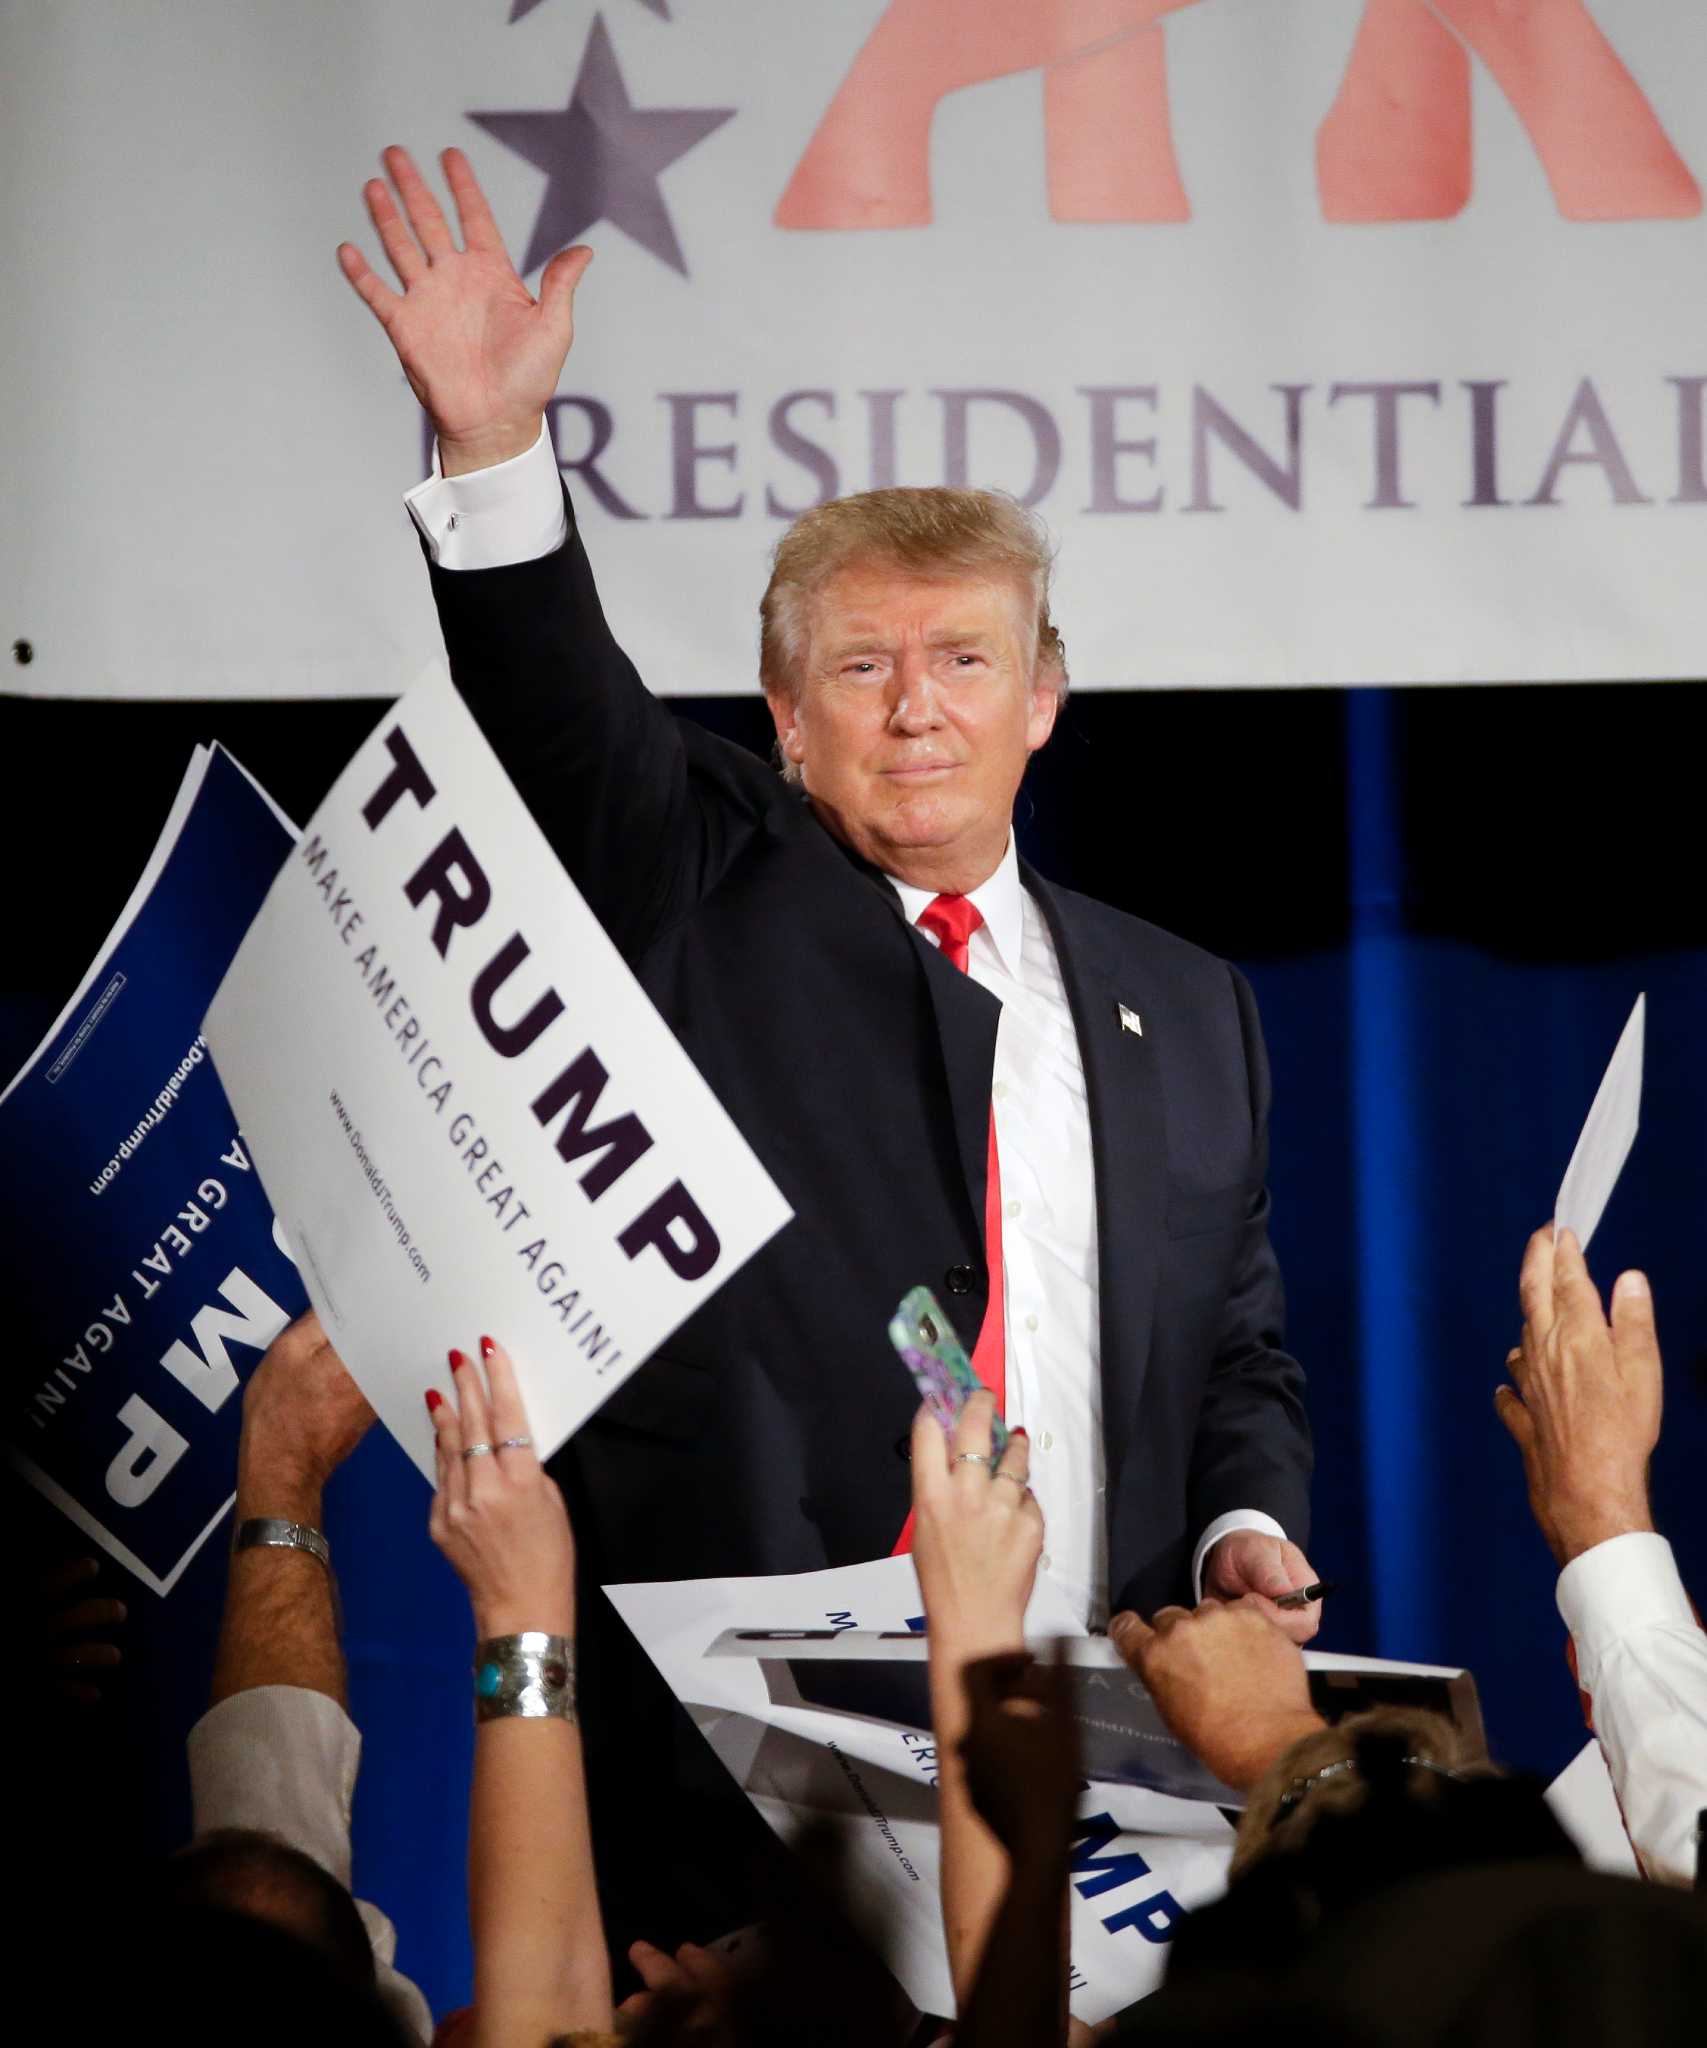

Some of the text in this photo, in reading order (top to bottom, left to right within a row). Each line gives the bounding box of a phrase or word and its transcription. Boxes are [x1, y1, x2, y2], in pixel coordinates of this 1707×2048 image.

[403, 375, 1707, 521] RESIDENTIAL
[361, 724, 721, 1282] TRUMP
[89, 1034, 208, 1196] w.DonaldJTrump.com
[303, 834, 622, 1375] MAKE AMERICA GREAT AGAIN!
[131, 1178, 228, 1300] GREAT
[329, 1088, 431, 1284] www.DonaldJTrump.com
[29, 1293, 133, 1430] AGAIN!
